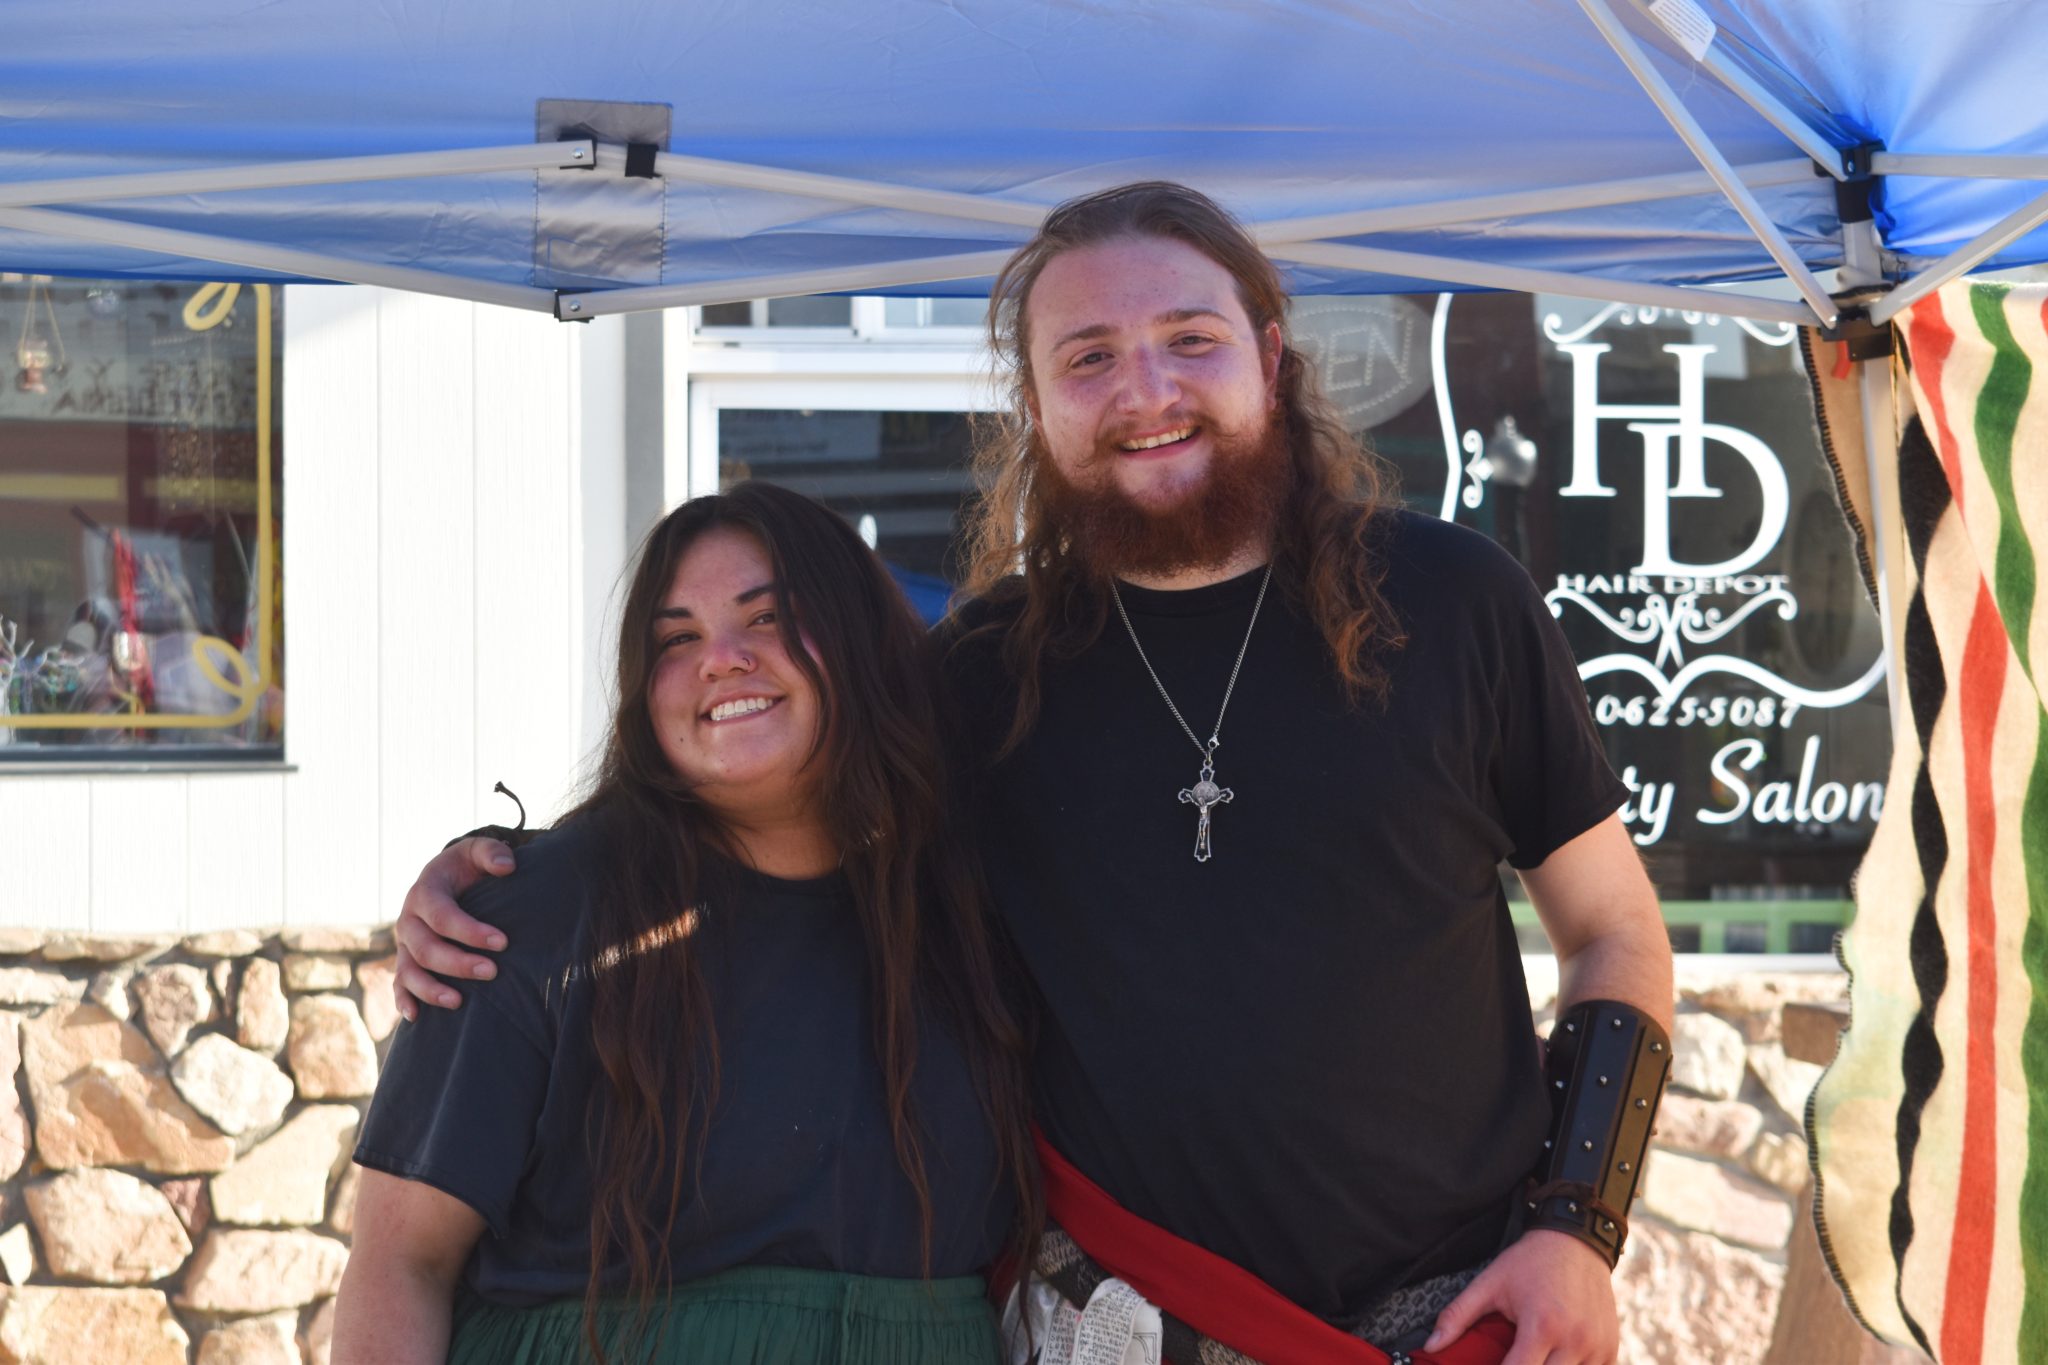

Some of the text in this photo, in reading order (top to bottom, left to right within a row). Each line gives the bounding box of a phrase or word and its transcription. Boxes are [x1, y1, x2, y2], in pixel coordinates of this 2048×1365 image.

[1557, 574, 1790, 595] HAIR DEPOT
[1617, 734, 1884, 846] ty Salon
